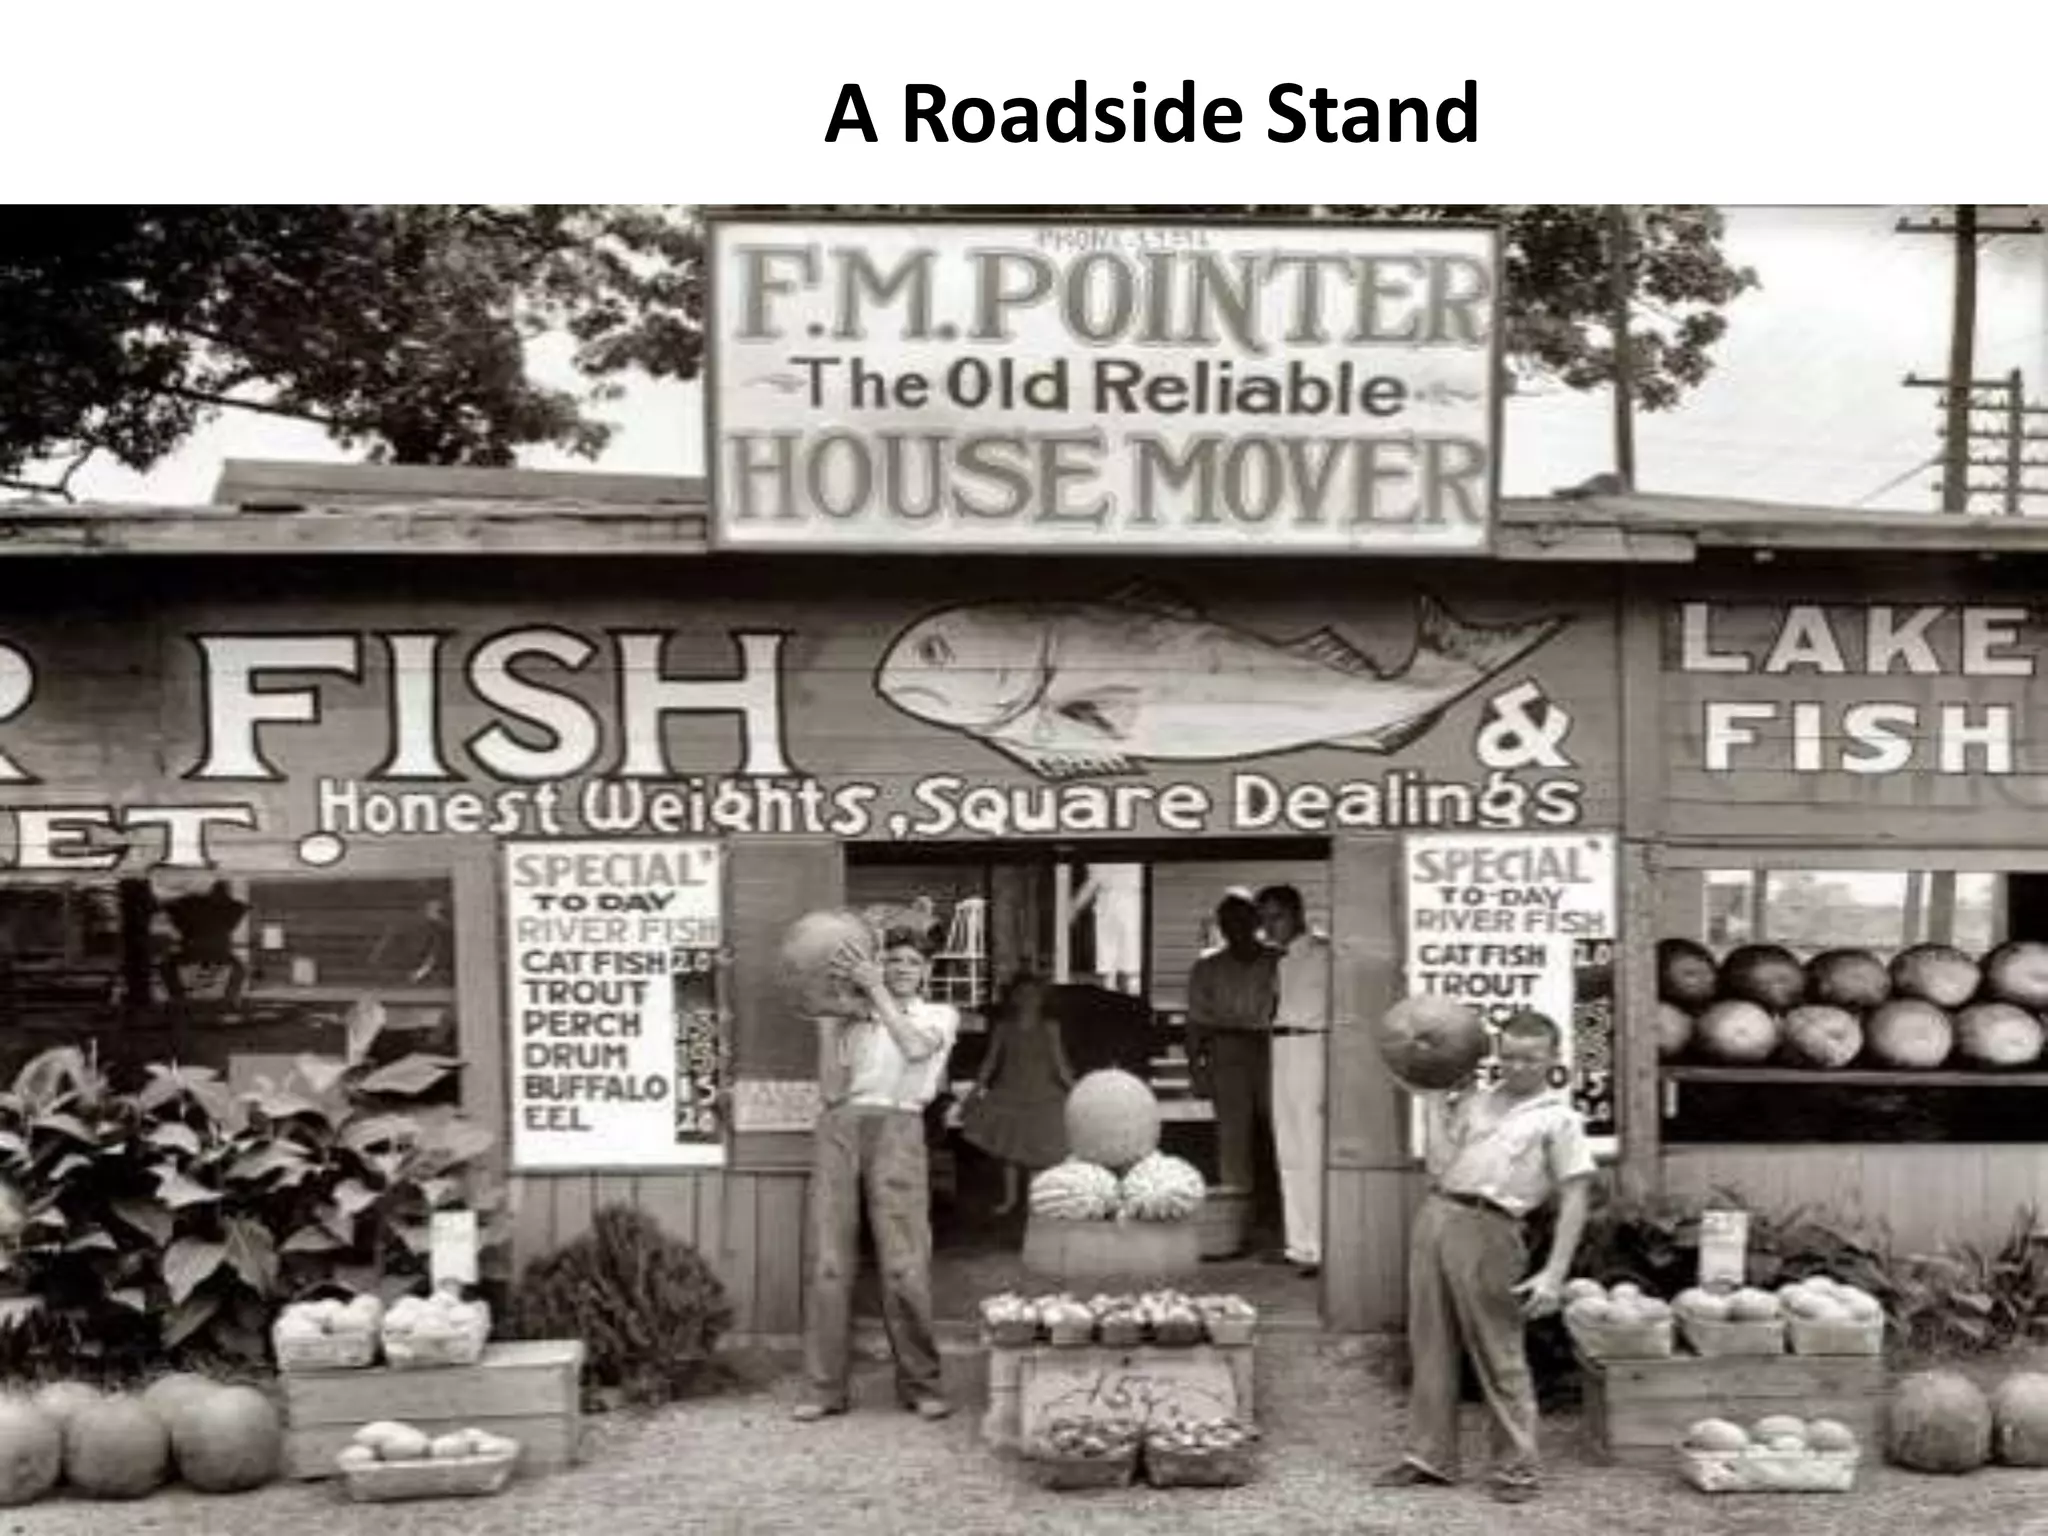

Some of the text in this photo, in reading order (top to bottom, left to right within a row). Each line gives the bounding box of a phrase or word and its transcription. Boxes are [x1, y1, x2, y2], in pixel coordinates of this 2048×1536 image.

[789, 355, 1405, 416] The Old Reliable
[728, 425, 1491, 526] HOUSE MOVER
[1681, 602, 2034, 676] LAKE
[182, 625, 808, 782] FISH
[1475, 678, 1573, 769] &
[1705, 702, 2012, 774] FISH
[319, 778, 560, 834] Honest
[1234, 773, 1581, 830] Dealings
[517, 916, 719, 944] RIVER FISH
[1413, 909, 1606, 934] RIVER FISH
[521, 980, 650, 1005] TROUT
[1418, 973, 1541, 997] TROUT
[522, 1009, 642, 1037] PERCH
[523, 1042, 628, 1069] DRUM
[522, 1074, 669, 1102] BUFFALO
[524, 1105, 593, 1131] EEL
